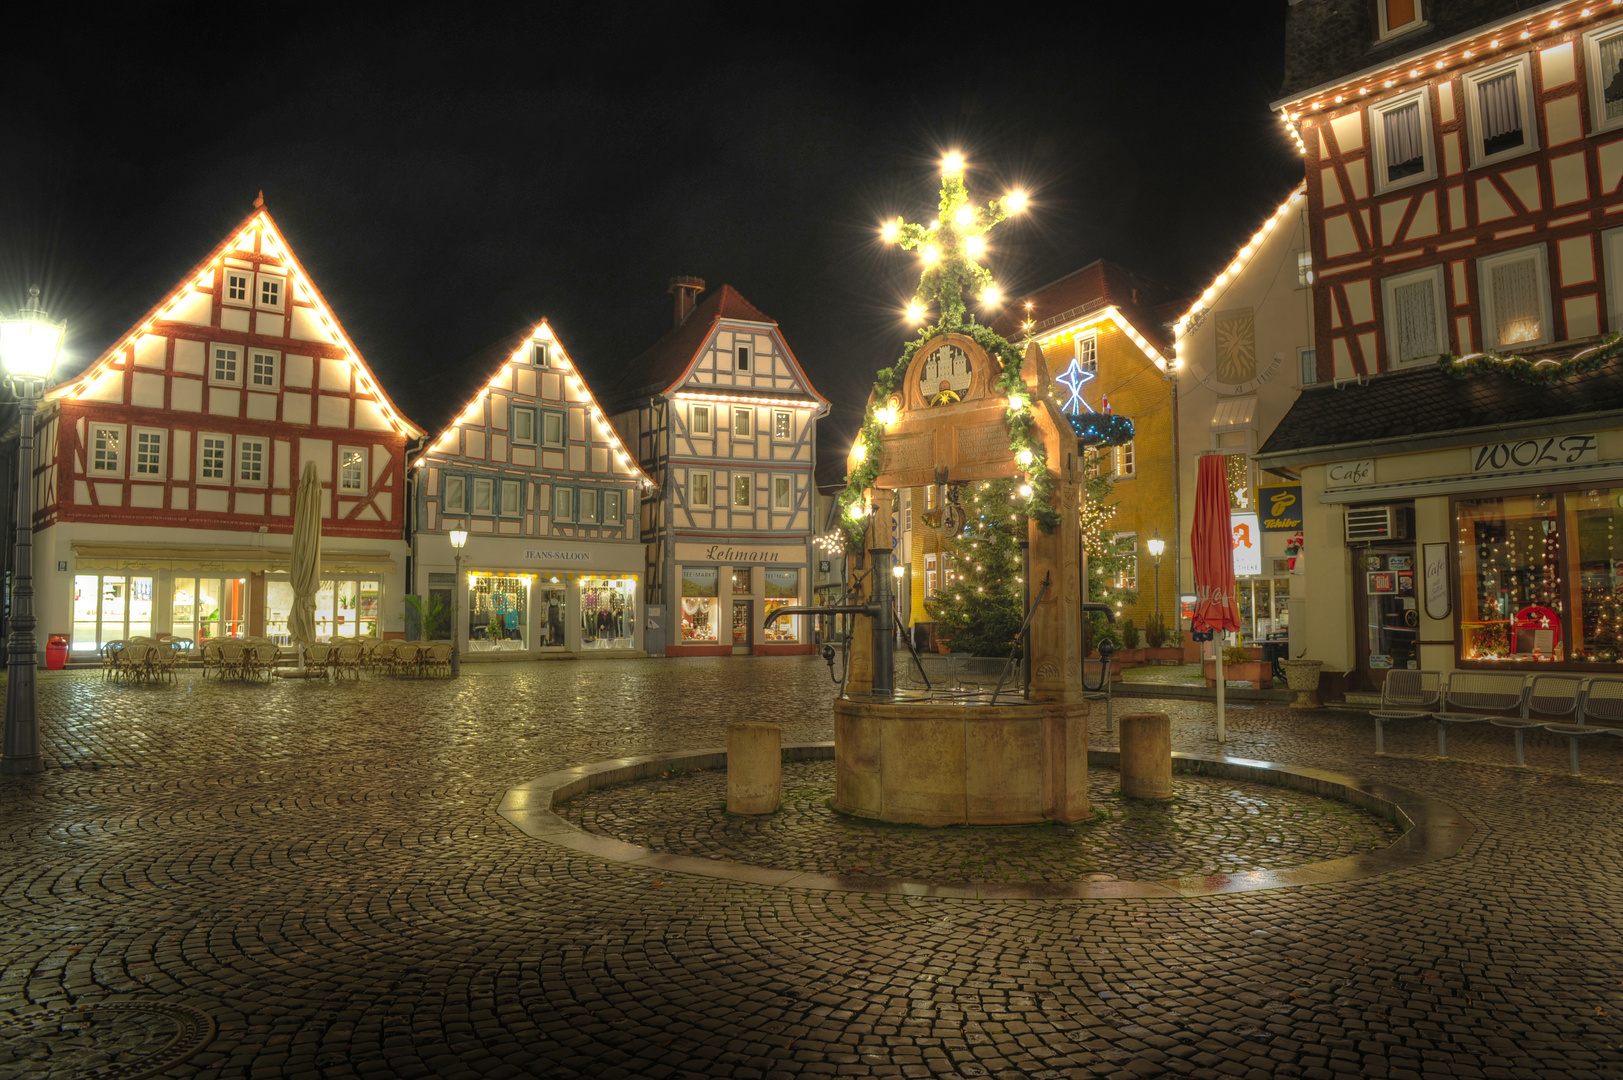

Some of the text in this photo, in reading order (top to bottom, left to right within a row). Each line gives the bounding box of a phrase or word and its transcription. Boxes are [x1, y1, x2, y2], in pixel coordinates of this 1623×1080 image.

[1475, 435, 1597, 471] WOLF
[1329, 462, 1370, 483] Café
[1263, 518, 1301, 529] Tchibo
[524, 551, 590, 561] JEANS-SALOON
[706, 545, 779, 562] Lehmann
[1376, 576, 1389, 588] Bild
